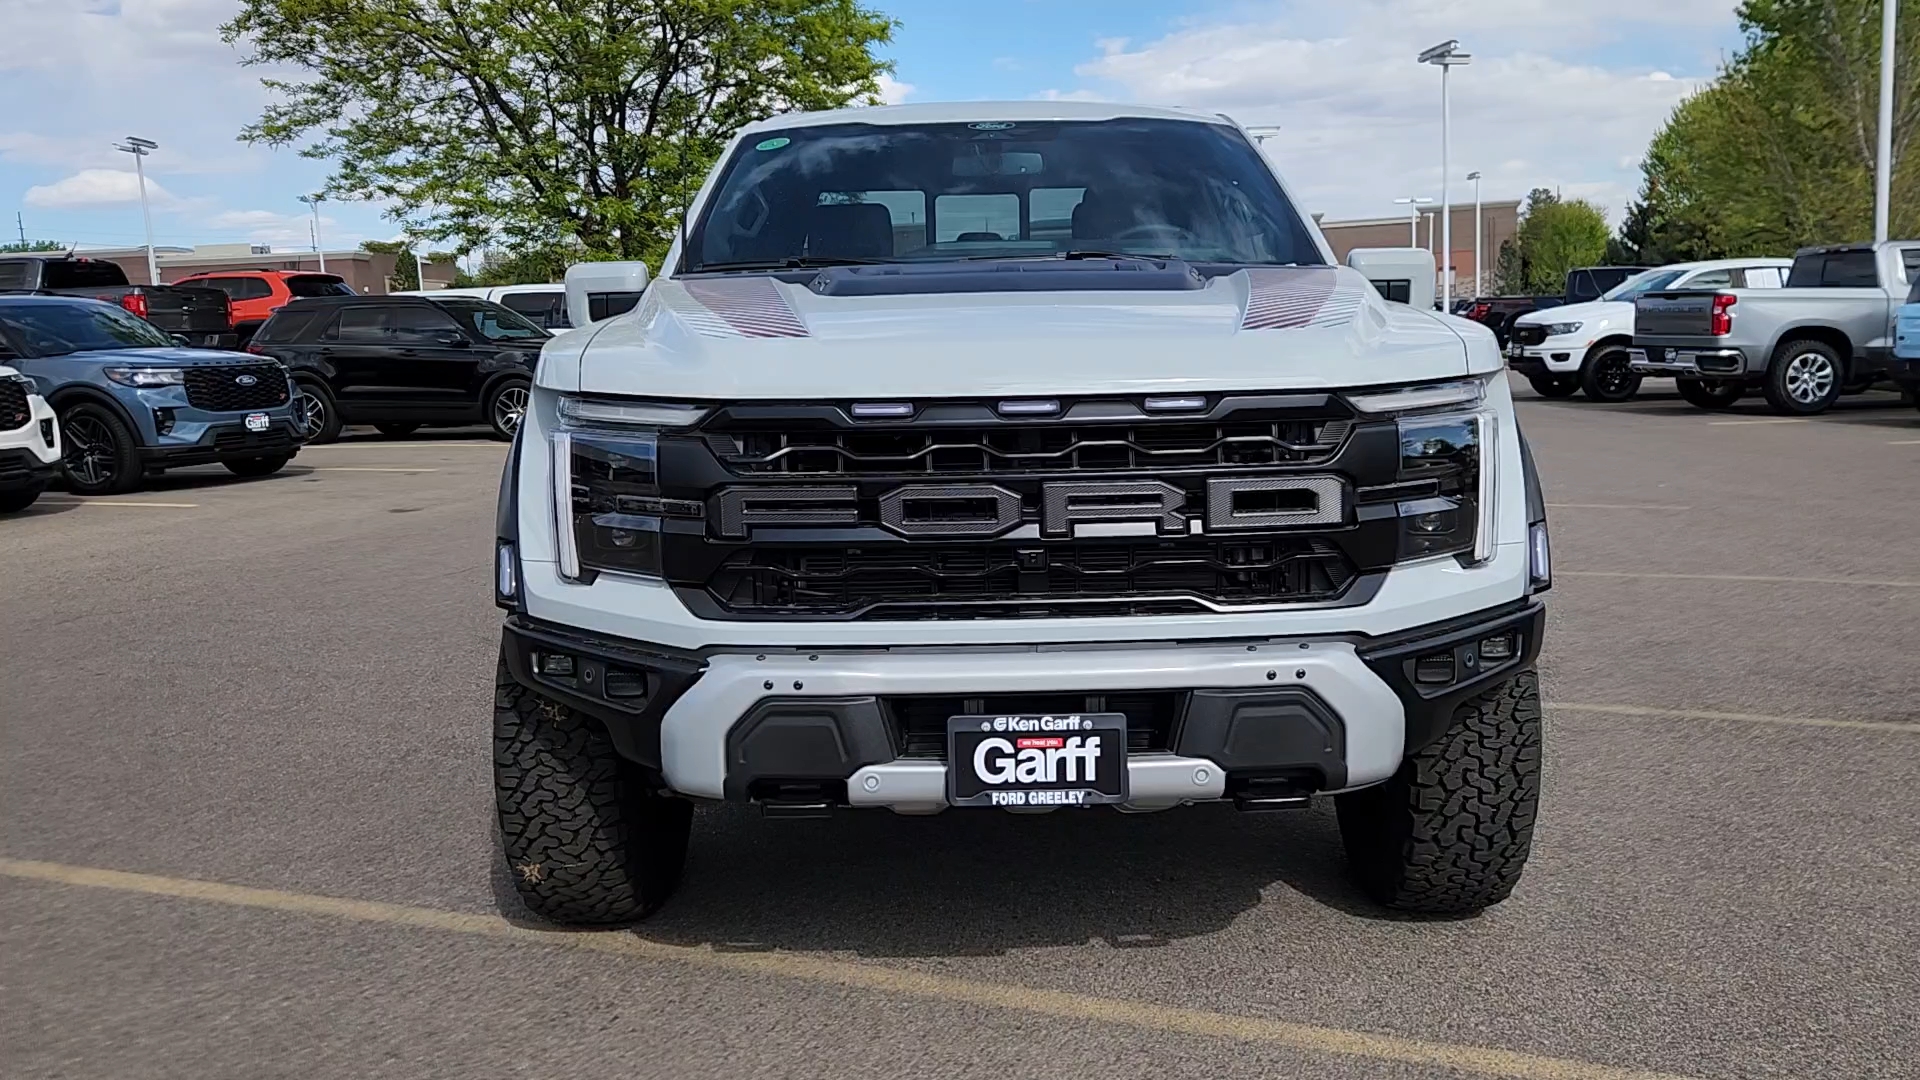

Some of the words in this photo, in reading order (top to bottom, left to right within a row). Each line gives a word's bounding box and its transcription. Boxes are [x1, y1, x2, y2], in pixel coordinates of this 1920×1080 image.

[245, 415, 270, 428] Garff
[713, 476, 1345, 540] FORD
[1008, 717, 1039, 731] Ken
[1040, 716, 1080, 731] Garff
[973, 736, 1101, 785] Garff
[992, 792, 1025, 805] FORD
[1028, 791, 1085, 805] GREELEY
